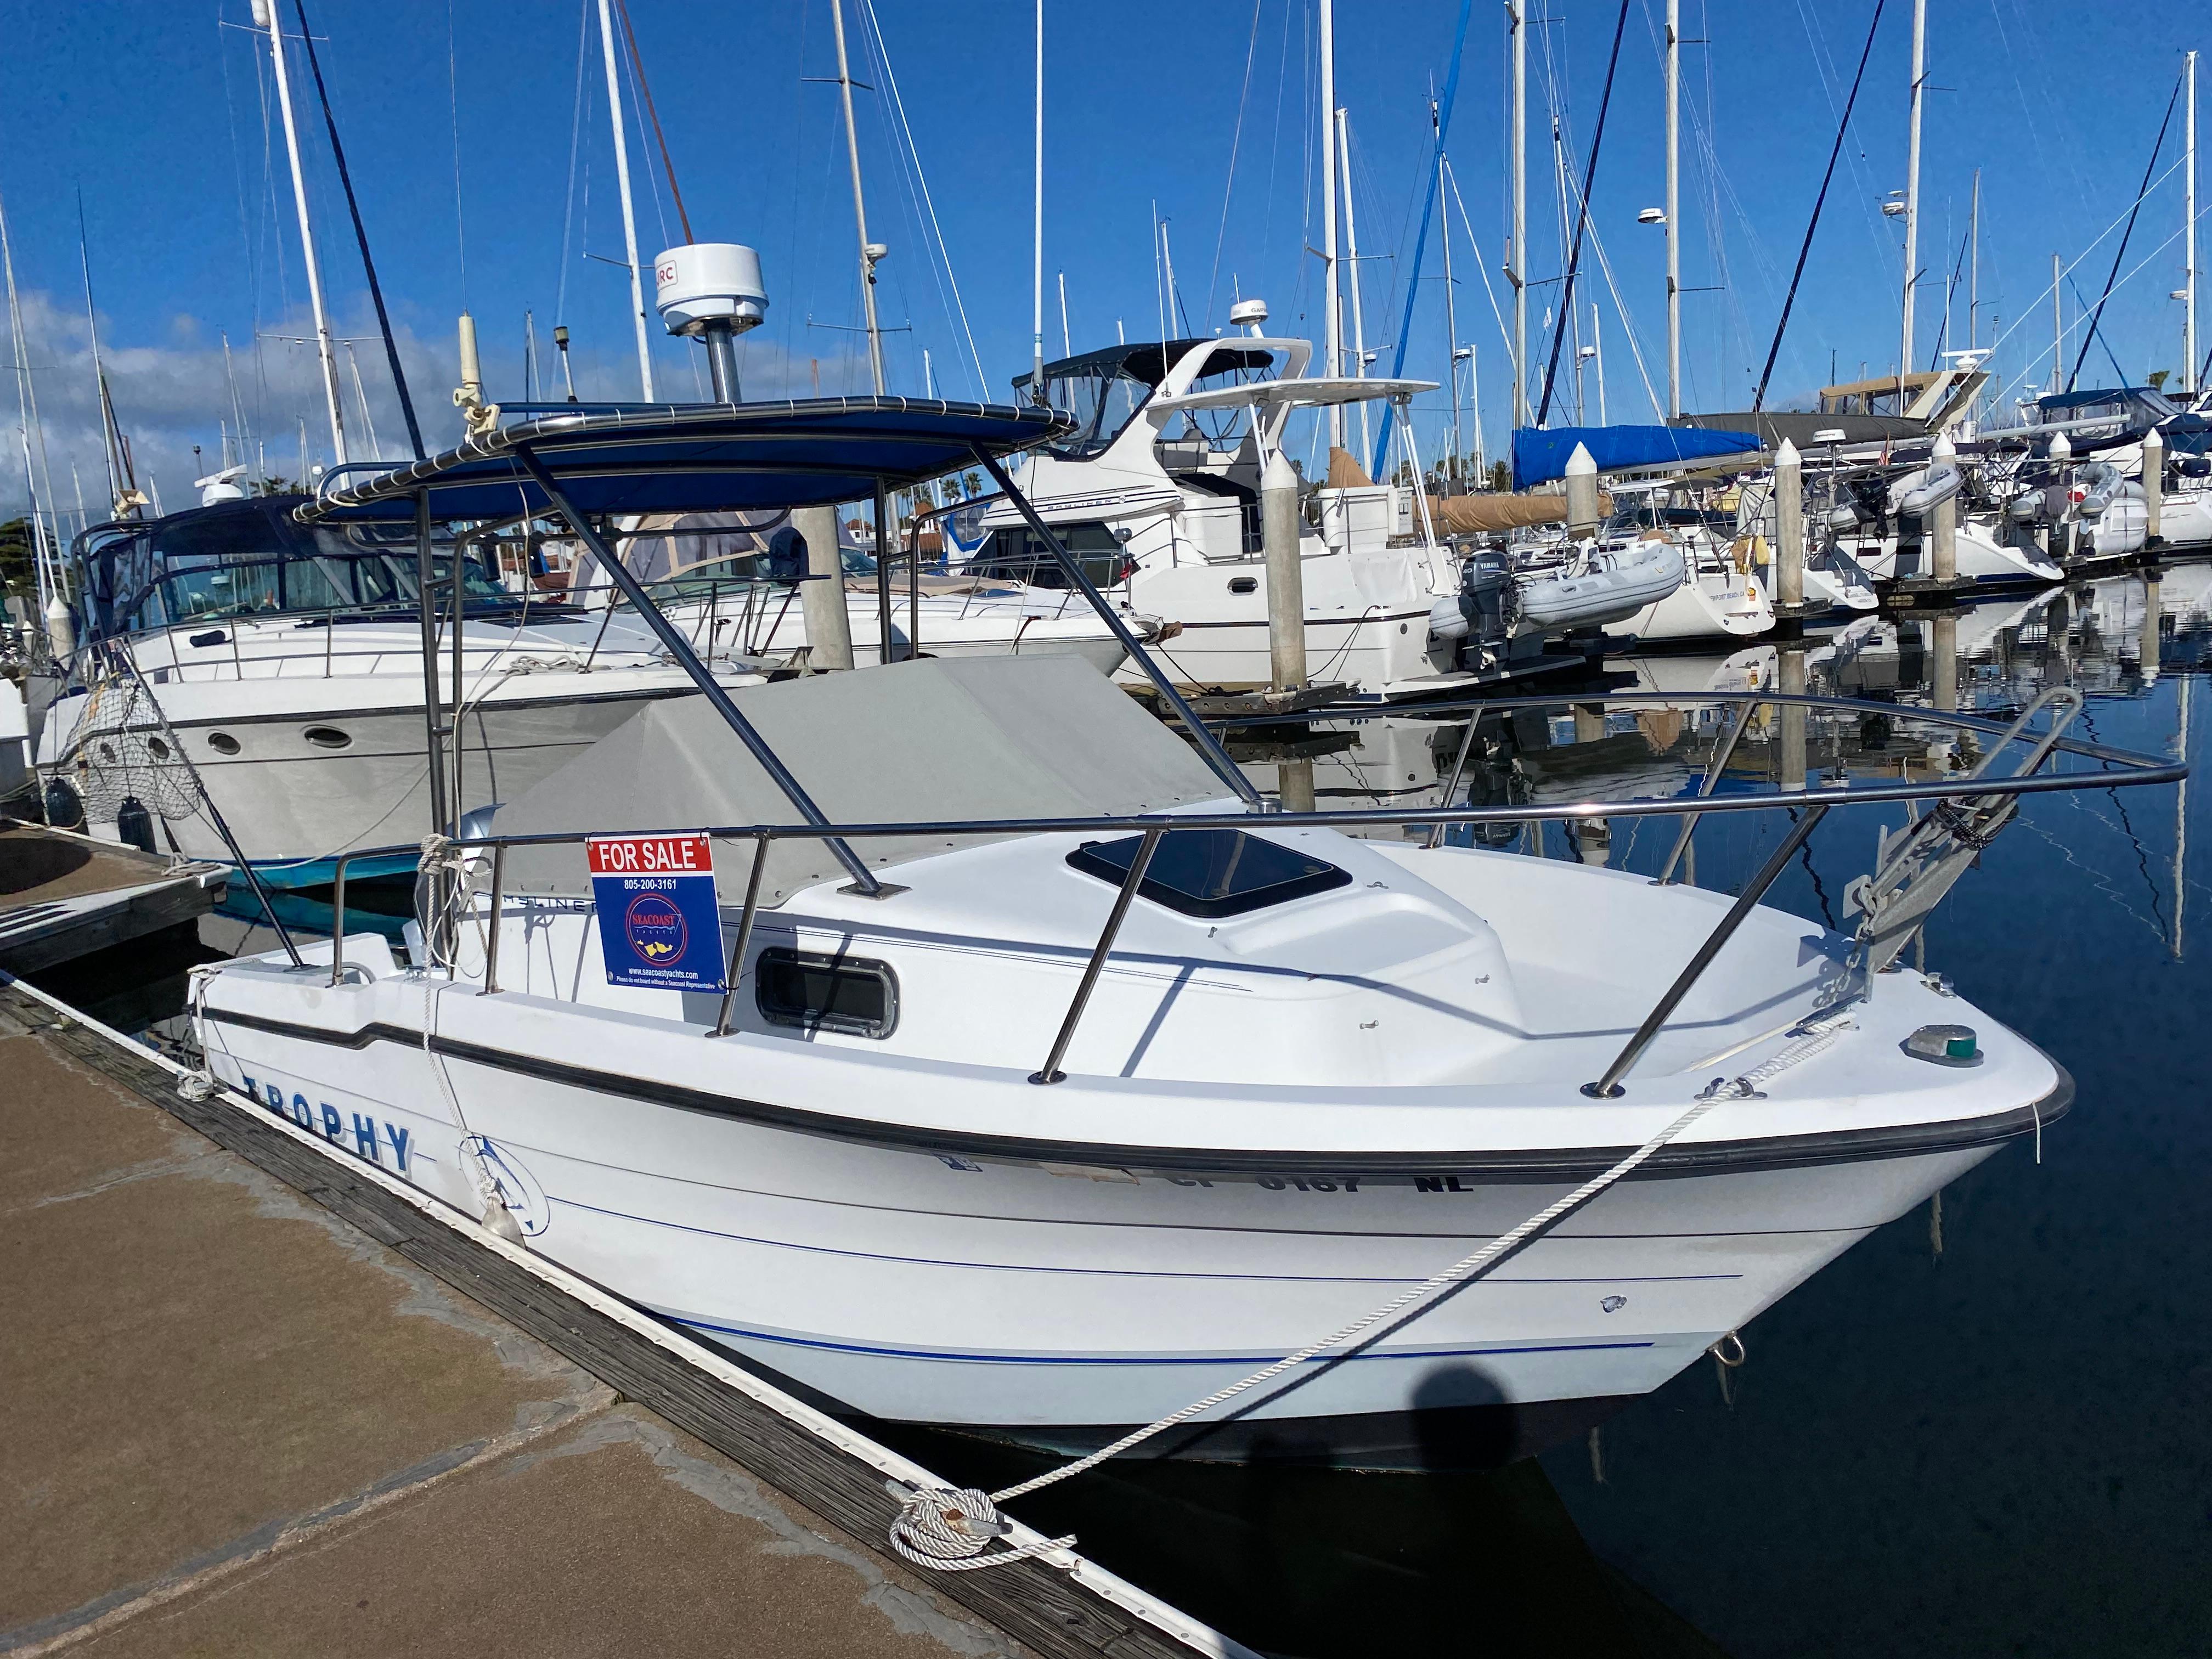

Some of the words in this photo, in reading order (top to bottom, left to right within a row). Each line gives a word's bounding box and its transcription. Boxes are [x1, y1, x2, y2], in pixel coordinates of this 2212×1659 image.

[599, 842, 640, 871] FOR
[643, 840, 697, 870] SALE
[624, 878, 676, 890] 805-200-3161
[632, 914, 675, 926] SEACOAST
[628, 968, 698, 979] www.seacoastyachts.com
[242, 1074, 411, 1173] TROPHY
[1413, 1176, 1474, 1193] NL
